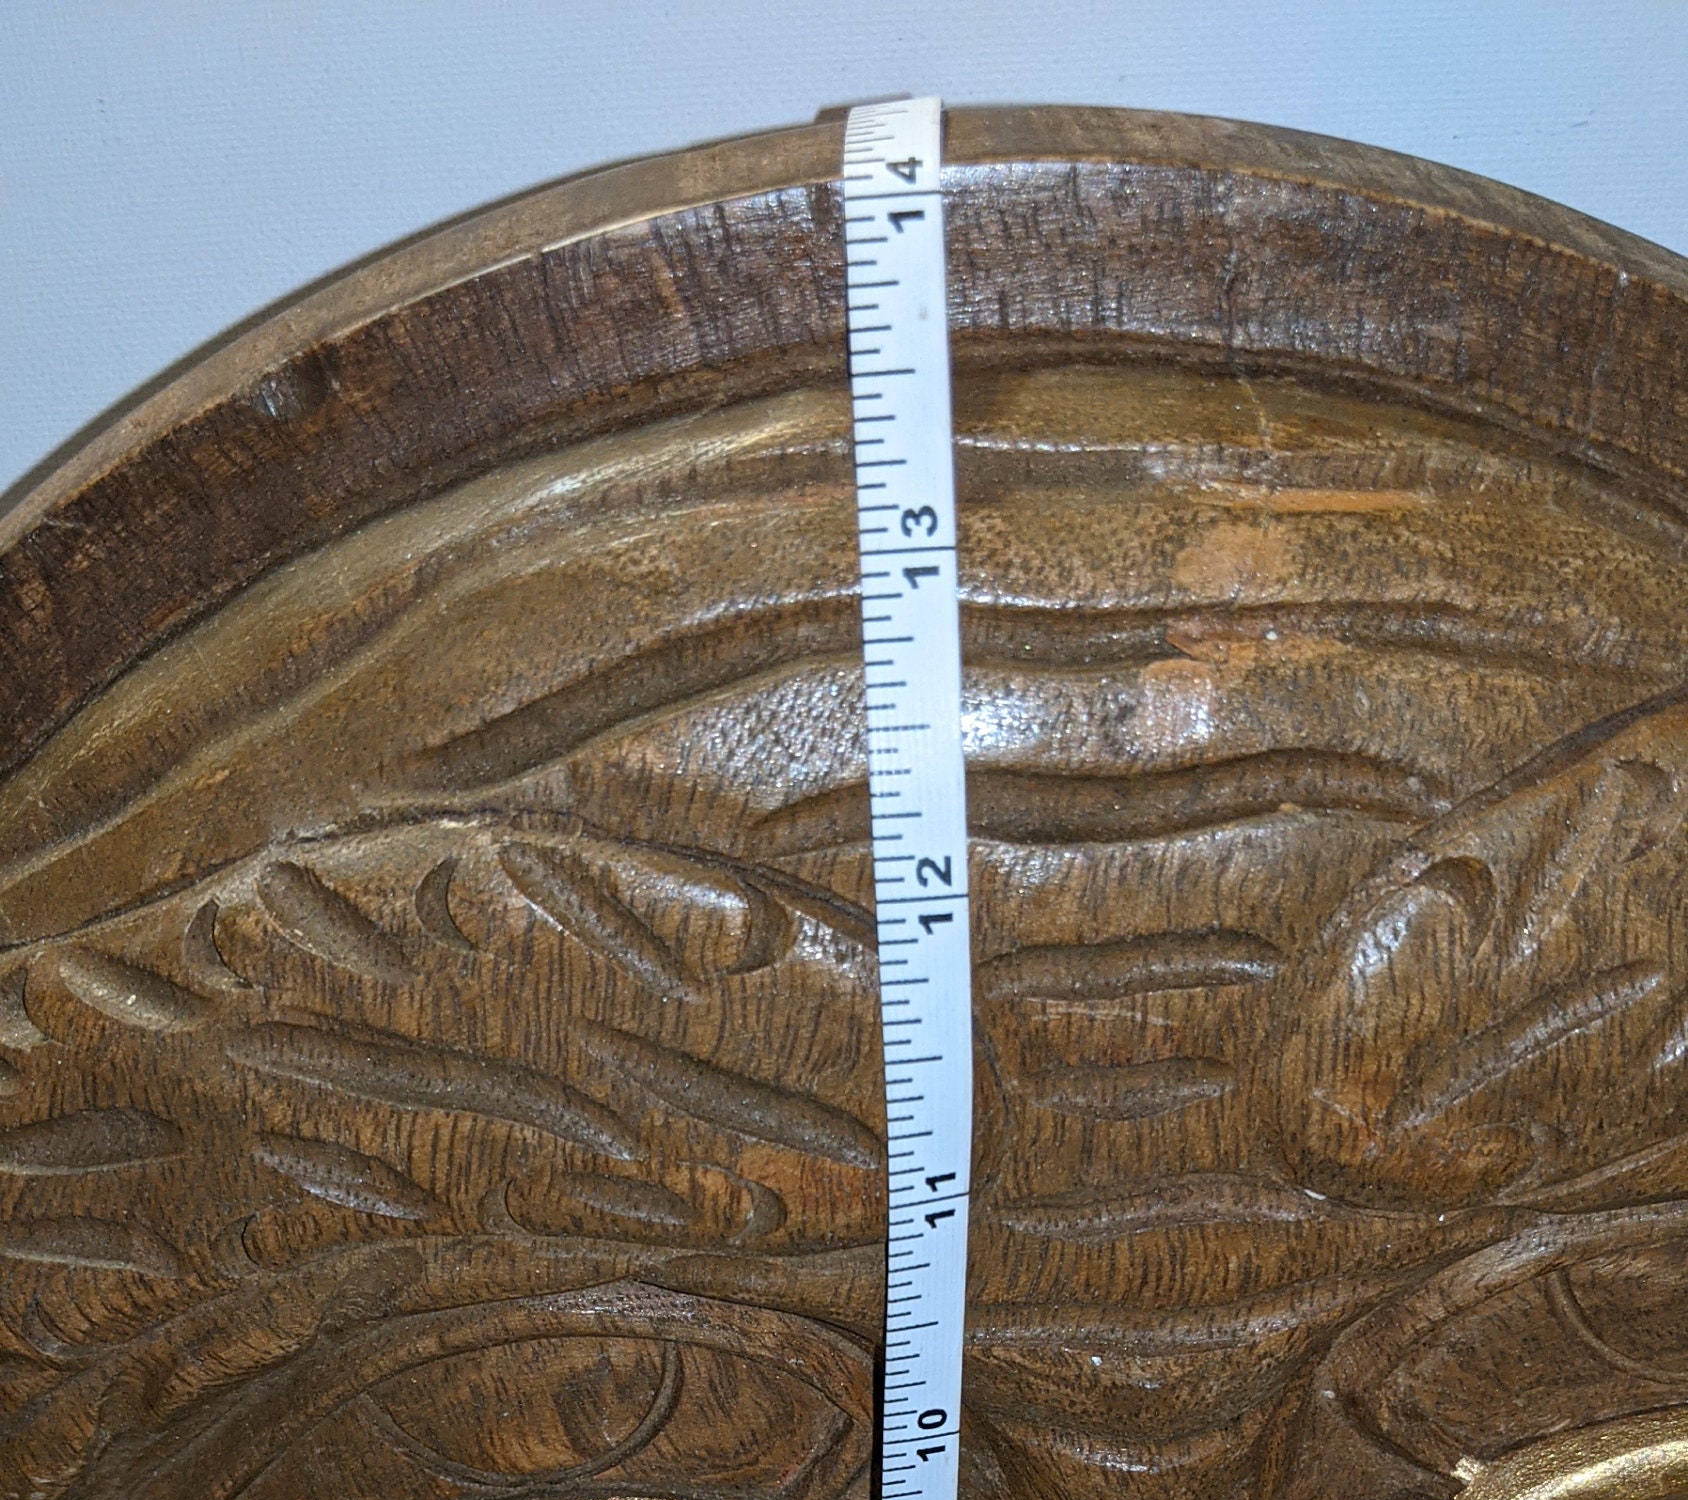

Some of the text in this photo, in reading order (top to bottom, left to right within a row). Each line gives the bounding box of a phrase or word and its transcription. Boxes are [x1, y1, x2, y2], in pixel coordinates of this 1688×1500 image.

[885, 156, 925, 234] 14
[900, 504, 940, 590] 13
[915, 854, 954, 936] 12
[924, 1171, 957, 1230] 11
[916, 1408, 948, 1462] 10
